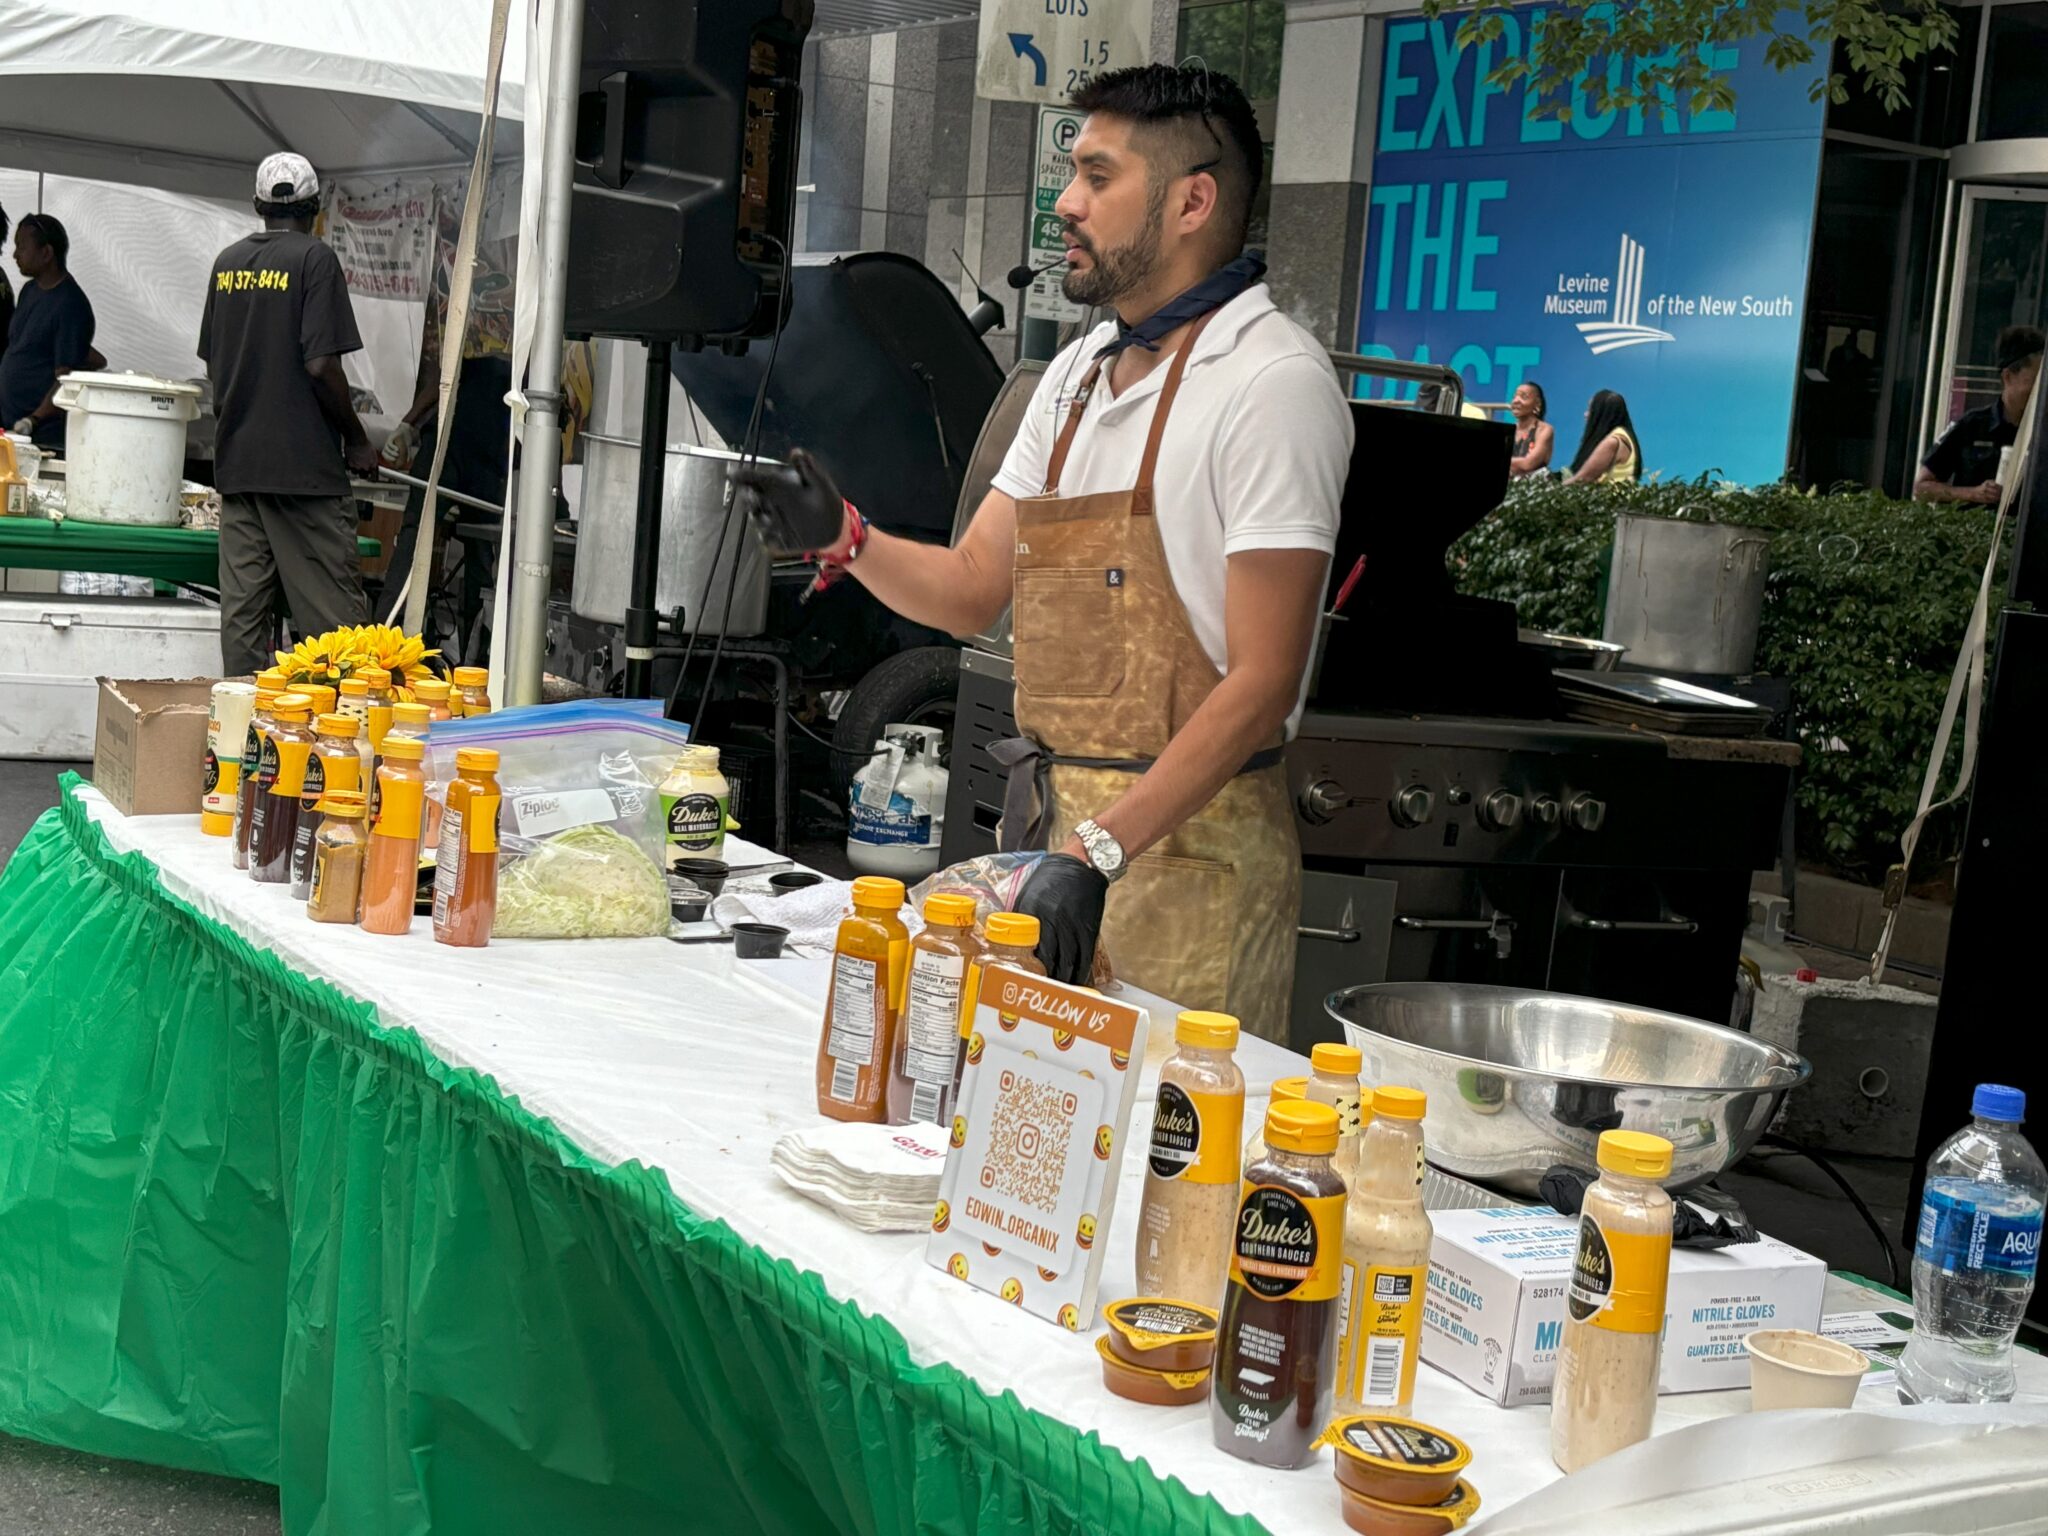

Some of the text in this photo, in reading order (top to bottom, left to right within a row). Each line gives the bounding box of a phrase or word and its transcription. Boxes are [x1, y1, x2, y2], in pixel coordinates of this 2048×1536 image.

[1379, 0, 1744, 152] EXPLORE
[1372, 180, 1508, 312] THE
[1558, 273, 1609, 293] Levine
[1544, 294, 1793, 316] Museum of the New South
[521, 798, 559, 817] Ziploc
[671, 806, 720, 824] Duke's
[1017, 988, 1111, 1033] FOLLOW US
[965, 1195, 1060, 1254] EDWIN_ORGANIX
[1242, 1207, 1314, 1246] Duke's
[1474, 1227, 1579, 1244] NITRILE GLOVE
[1973, 1212, 1990, 1269] RECYCLE
[1241, 1241, 1311, 1264] SOUTHERN SAUCES
[1502, 1247, 1571, 1259] GUANTES DE
[1577, 1245, 1607, 1275] uke's
[1459, 1274, 1472, 1286] BLACK
[1427, 1270, 1447, 1292] RILE
[1449, 1281, 1483, 1312] GLOVES
[1532, 1288, 1564, 1299] 528174
[1710, 1297, 1742, 1305] POWDER-FREE
[1692, 1304, 1776, 1323] NITRILE GLOVES
[1440, 1316, 1449, 1330] DE
[1451, 1321, 1479, 1346] NITRILO
[1687, 1343, 1725, 1357] GUANTES
[1727, 1343, 1739, 1354] DE
[1238, 1403, 1270, 1423] Duke's
[1234, 1423, 1271, 1443] Twang!
